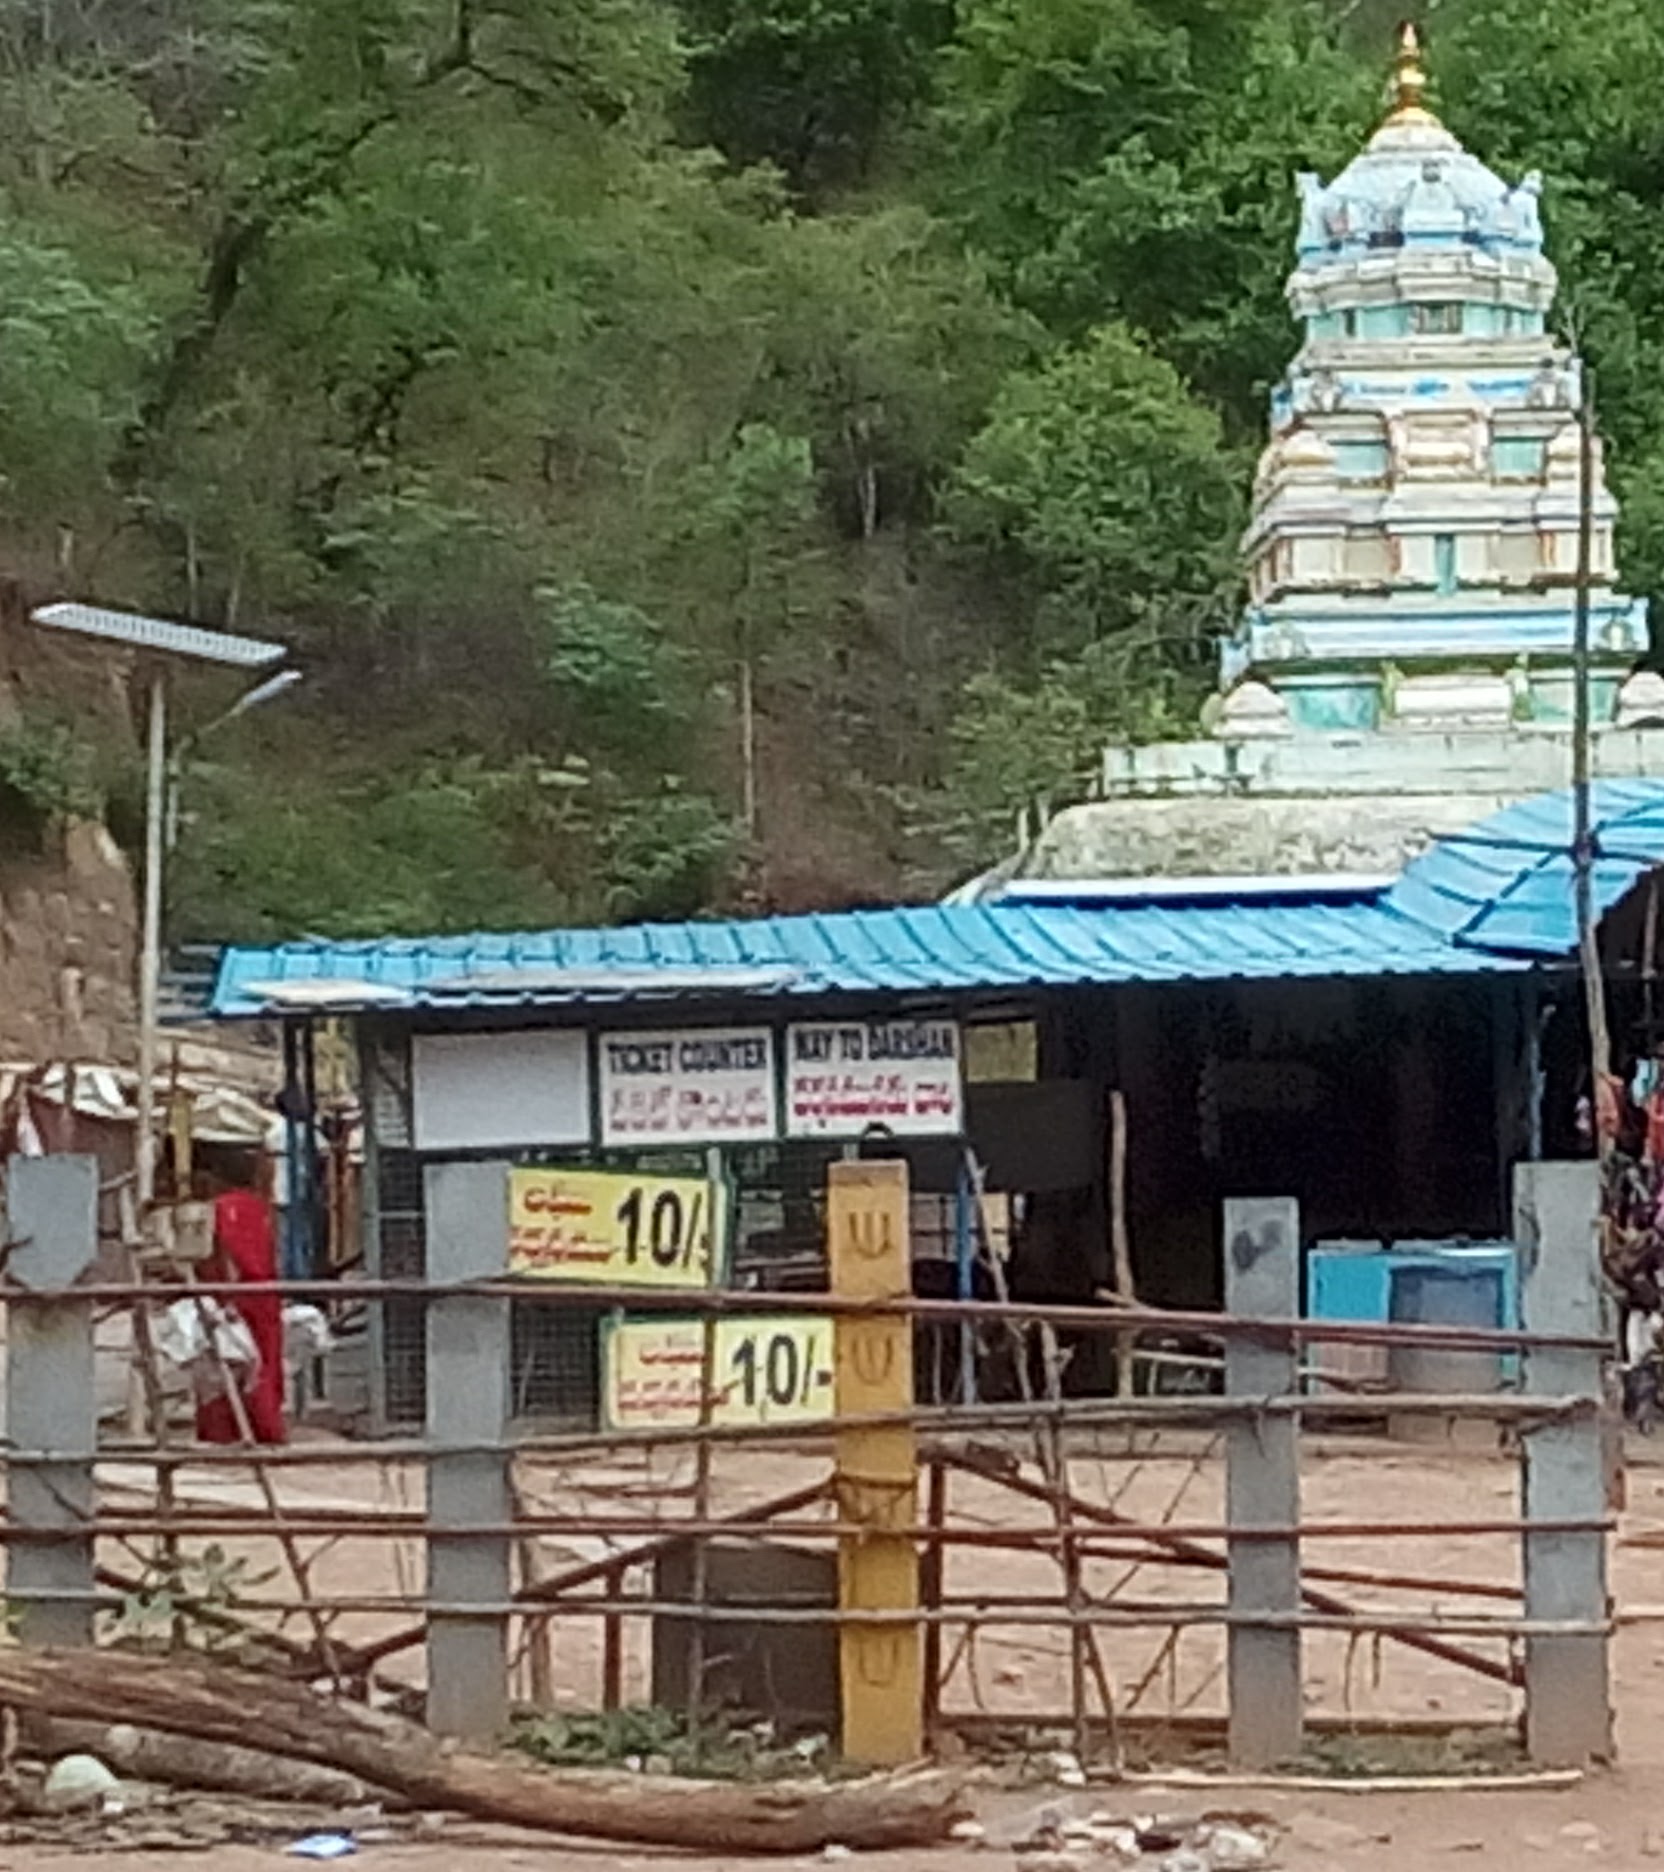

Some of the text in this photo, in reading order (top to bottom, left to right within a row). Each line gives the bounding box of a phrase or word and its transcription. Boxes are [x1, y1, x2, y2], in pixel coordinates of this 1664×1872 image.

[607, 1038, 767, 1073] TICKET COUNTER
[840, 1028, 863, 1060] TO
[732, 1333, 833, 1406] 10/-
